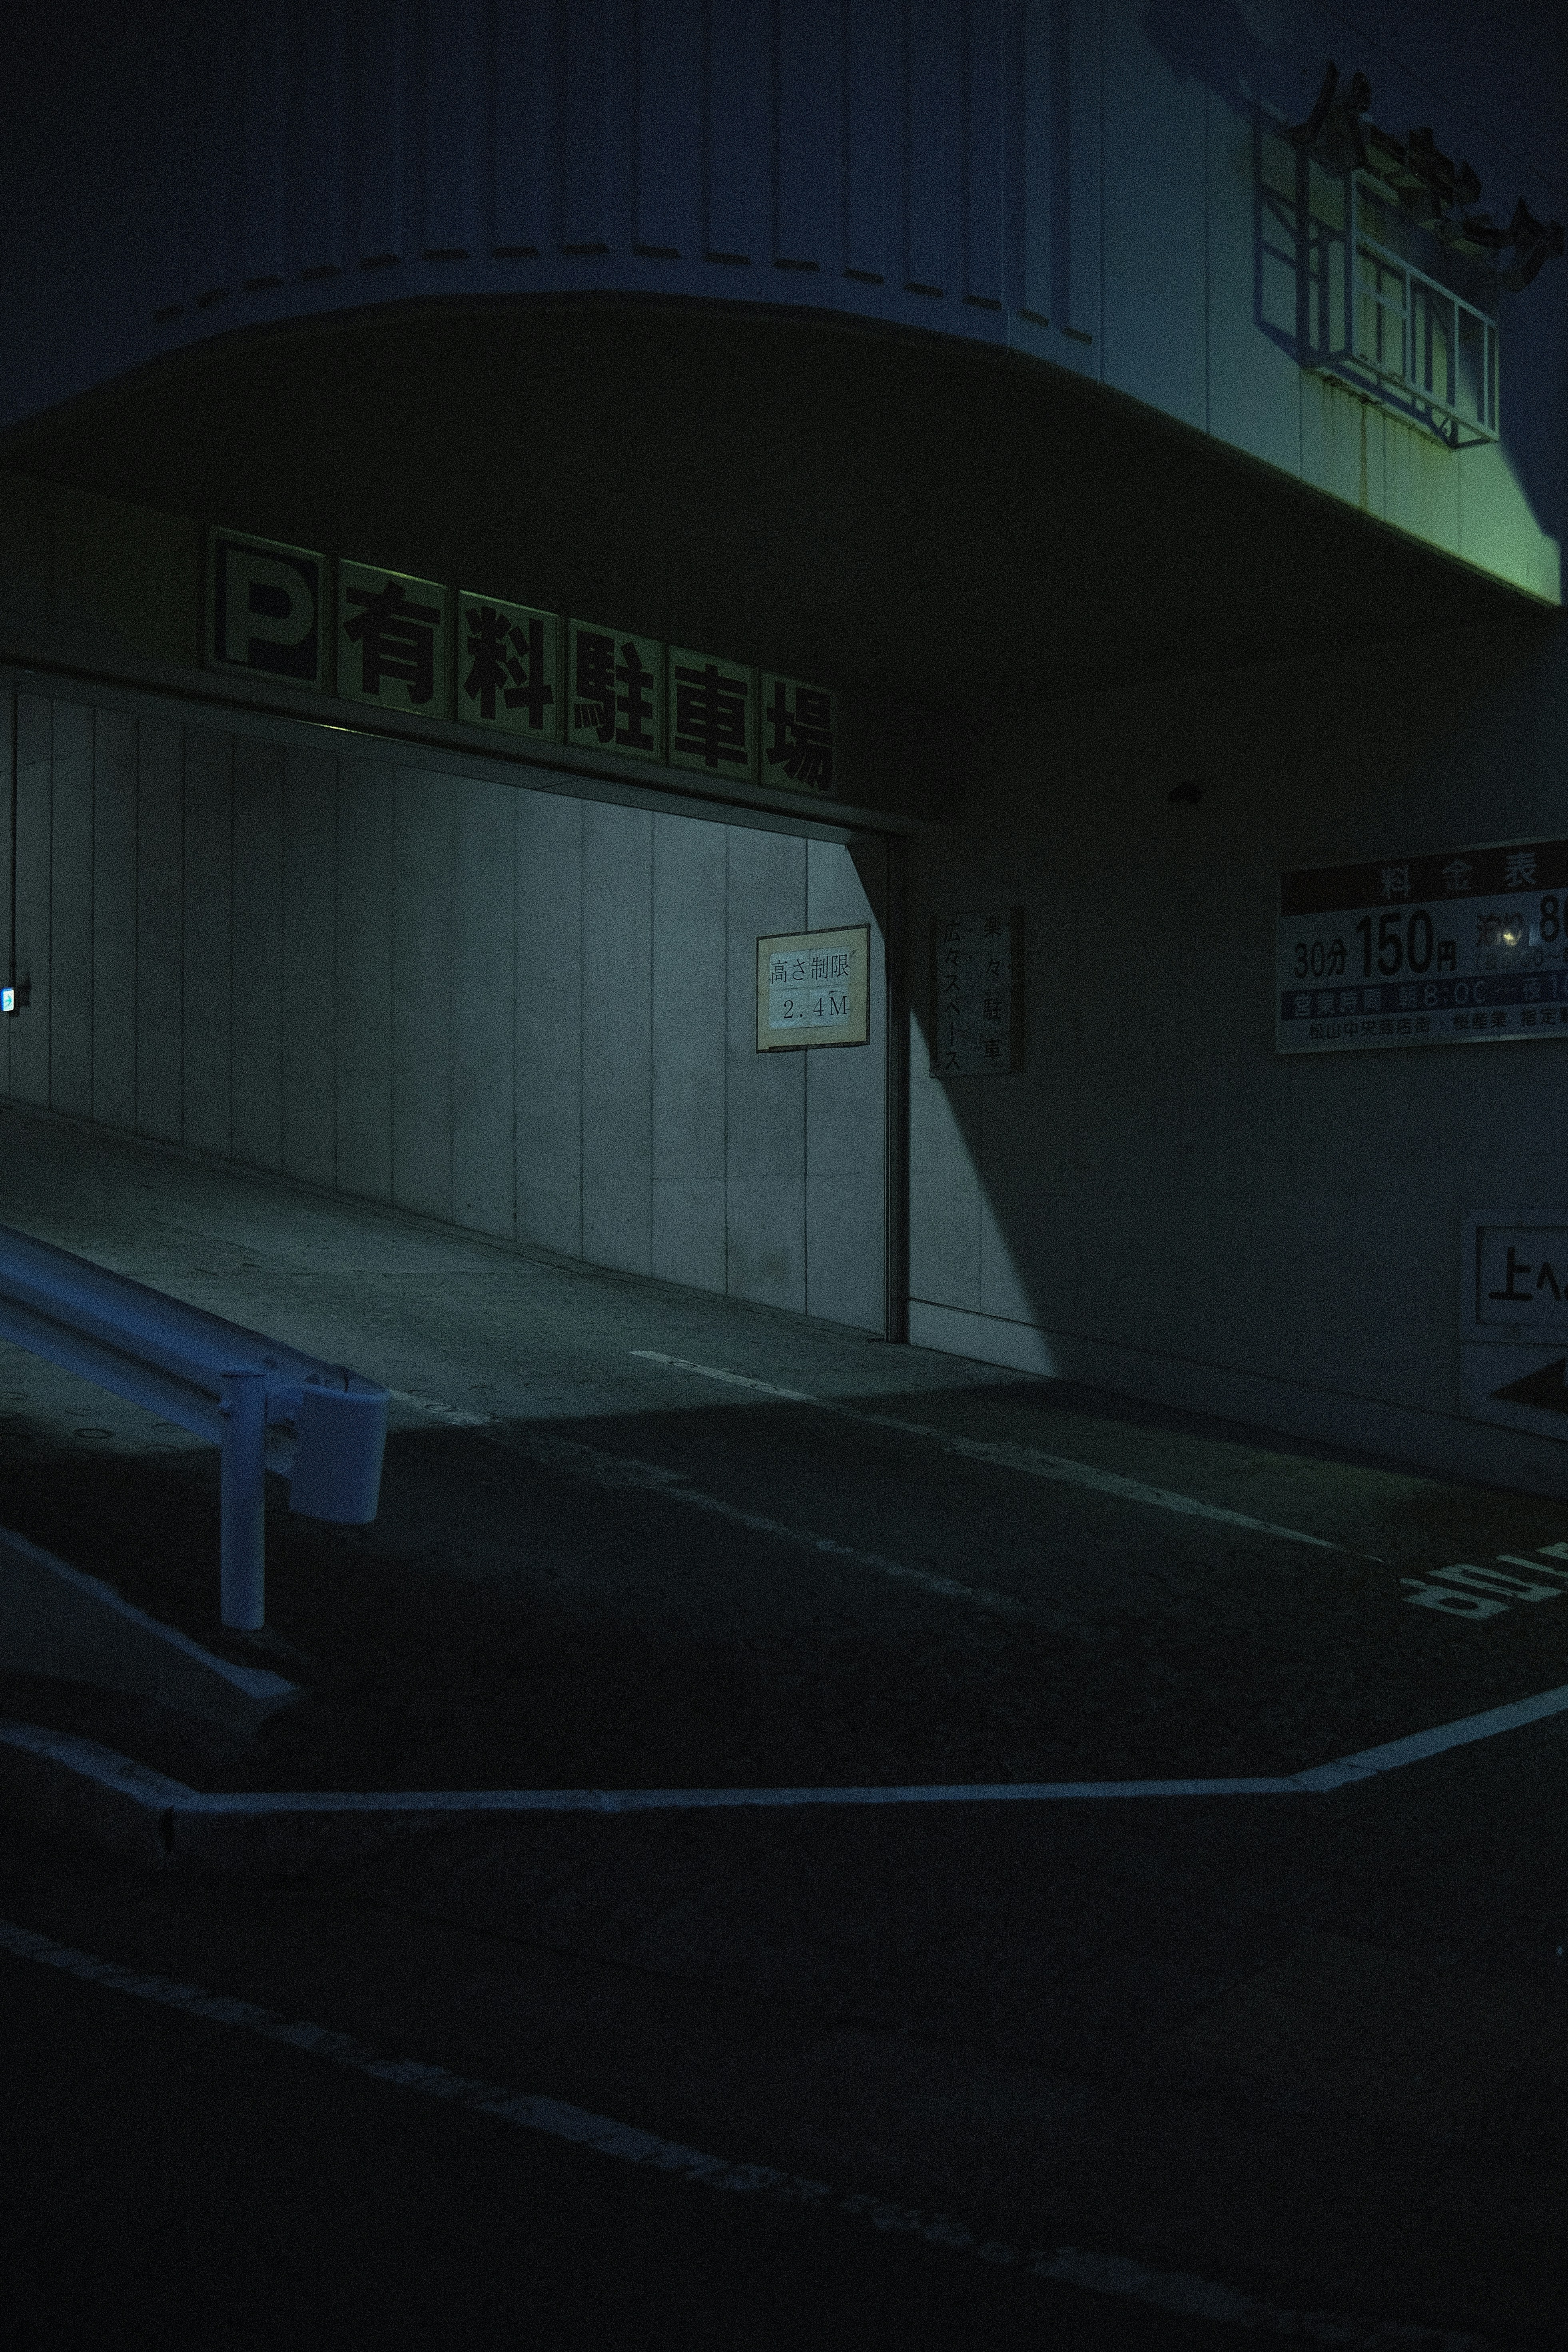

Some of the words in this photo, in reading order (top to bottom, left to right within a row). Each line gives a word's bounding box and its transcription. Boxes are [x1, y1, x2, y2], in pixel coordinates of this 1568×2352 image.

[224, 548, 318, 664] P
[343, 581, 835, 791] 有料駐車場
[1380, 852, 1538, 900] 料金表
[771, 954, 849, 984] 高さ制限
[1294, 940, 1347, 978] 30分
[1355, 910, 1456, 978] 150円
[783, 995, 848, 1019] 2.4M
[944, 920, 961, 1070] 広々スペース
[983, 916, 1003, 1061] 楽々駐車
[1294, 988, 1381, 1017] 営業時間
[1489, 1246, 1568, 1301] 上へ
